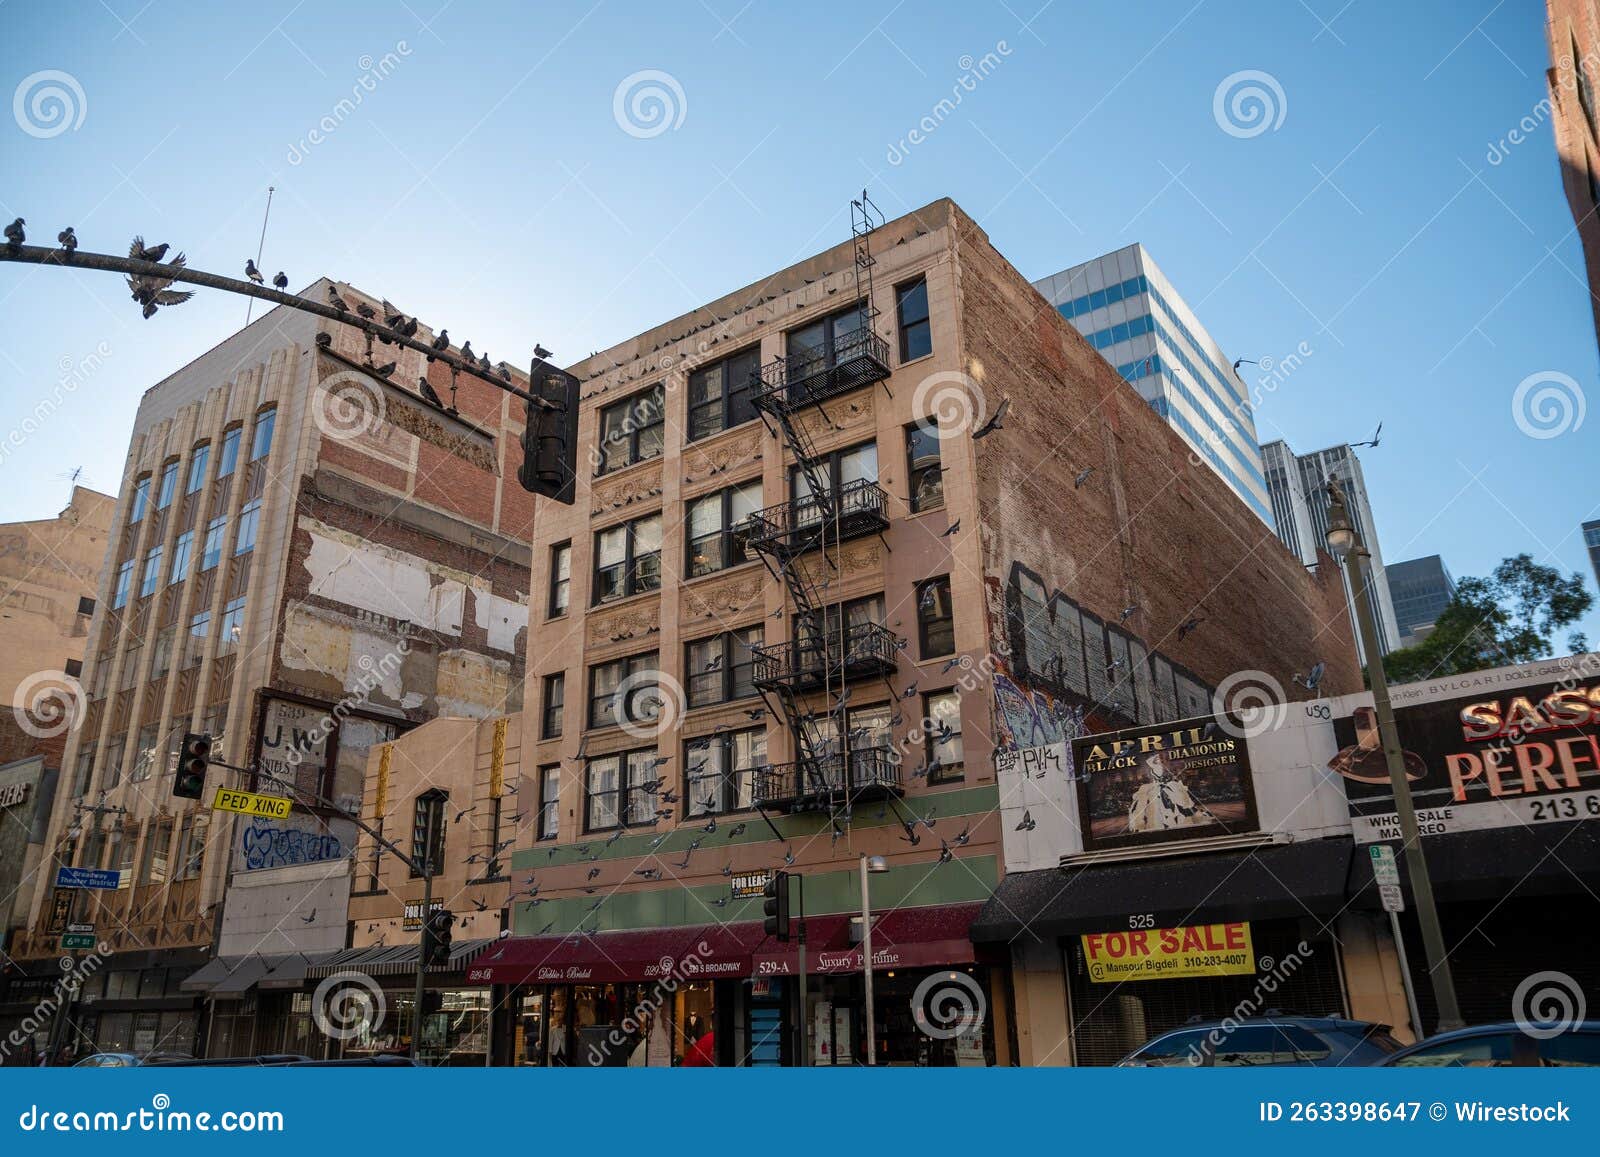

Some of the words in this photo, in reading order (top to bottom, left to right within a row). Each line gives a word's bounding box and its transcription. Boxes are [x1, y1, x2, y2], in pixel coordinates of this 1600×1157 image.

[1429, 675, 1501, 695] BVLGARI
[1084, 727, 1214, 763] APRIL
[1086, 756, 1137, 774] BLACK
[1183, 754, 1237, 770] DESIGNER
[220, 793, 249, 809] PED
[253, 798, 285, 815] XING
[1530, 797, 1578, 820] 213
[1369, 809, 1453, 827] WHOSALE
[1380, 823, 1447, 839] MAREO
[60, 876, 88, 885] Theater
[89, 879, 117, 888] District
[73, 870, 108, 880] Broadway
[731, 876, 747, 890] FOR
[748, 874, 771, 888] LEAS
[404, 905, 420, 919] FOR
[1128, 914, 1156, 929] 525
[1085, 930, 1150, 960] FOR
[1159, 924, 1248, 955] SALE
[706, 962, 741, 973] BROADWAY
[759, 962, 789, 974] 529-A
[816, 952, 852, 971] Luxury
[1095, 967, 1104, 976] 21
[1106, 961, 1143, 974] Mansour
[1145, 957, 1178, 972] Bigdeli
